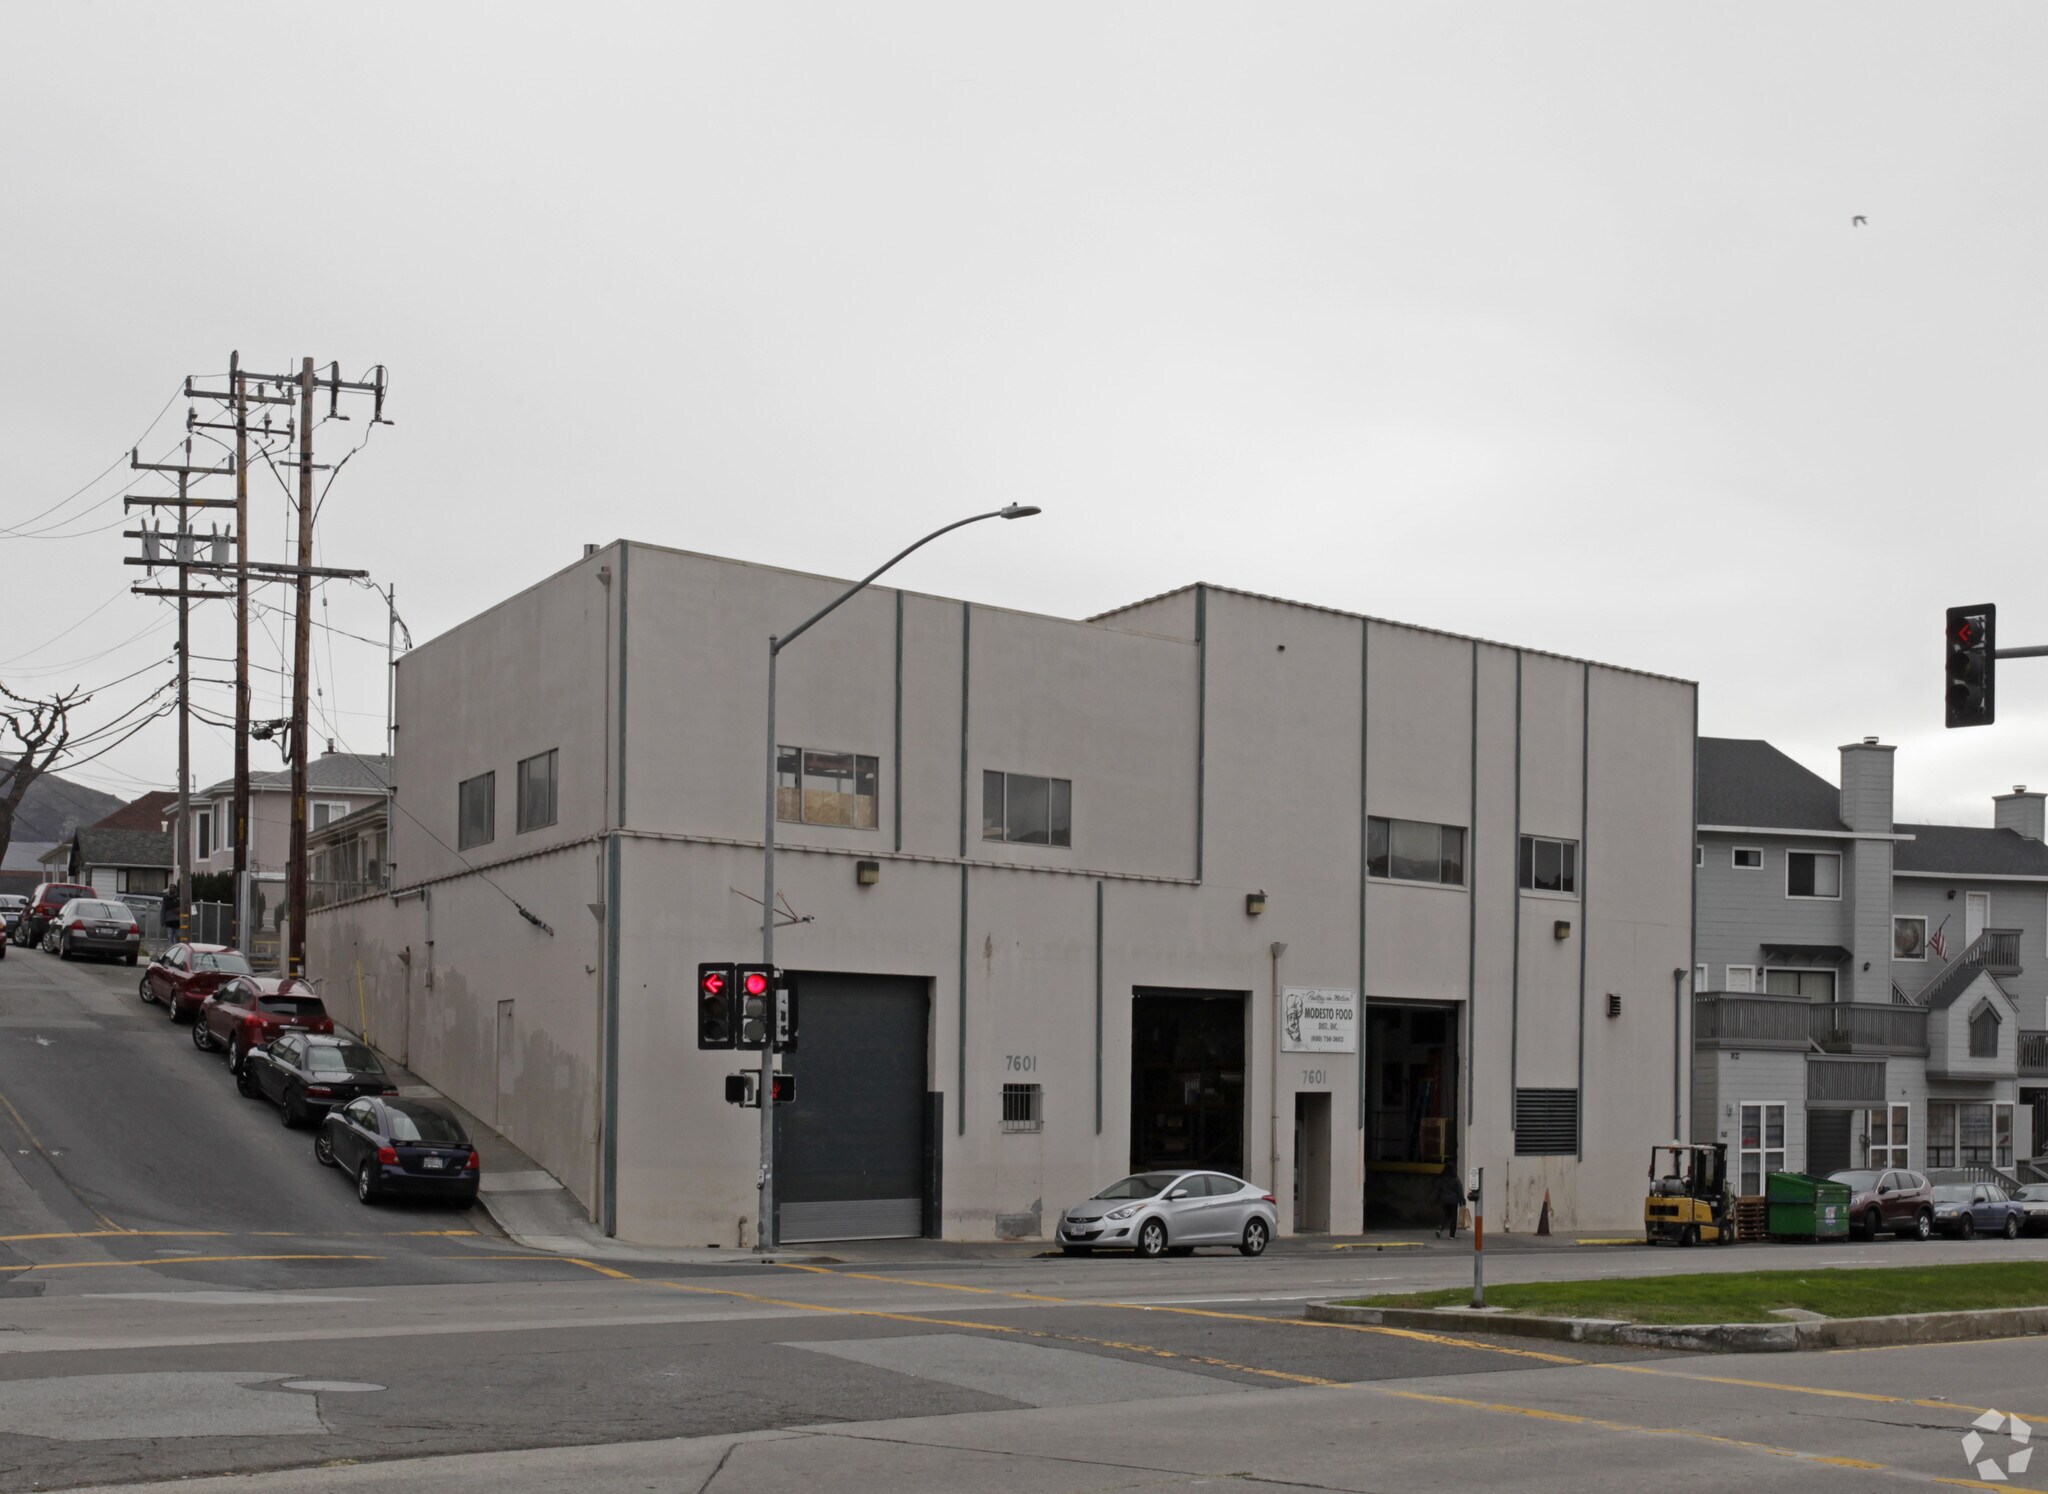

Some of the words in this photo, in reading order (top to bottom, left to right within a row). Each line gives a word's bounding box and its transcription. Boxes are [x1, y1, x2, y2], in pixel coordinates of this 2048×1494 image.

[1304, 1007, 1334, 1019] MODESTO
[1335, 1008, 1353, 1020] FOOD
[1006, 1055, 1036, 1072] 7601
[1302, 1070, 1326, 1084] 7601
